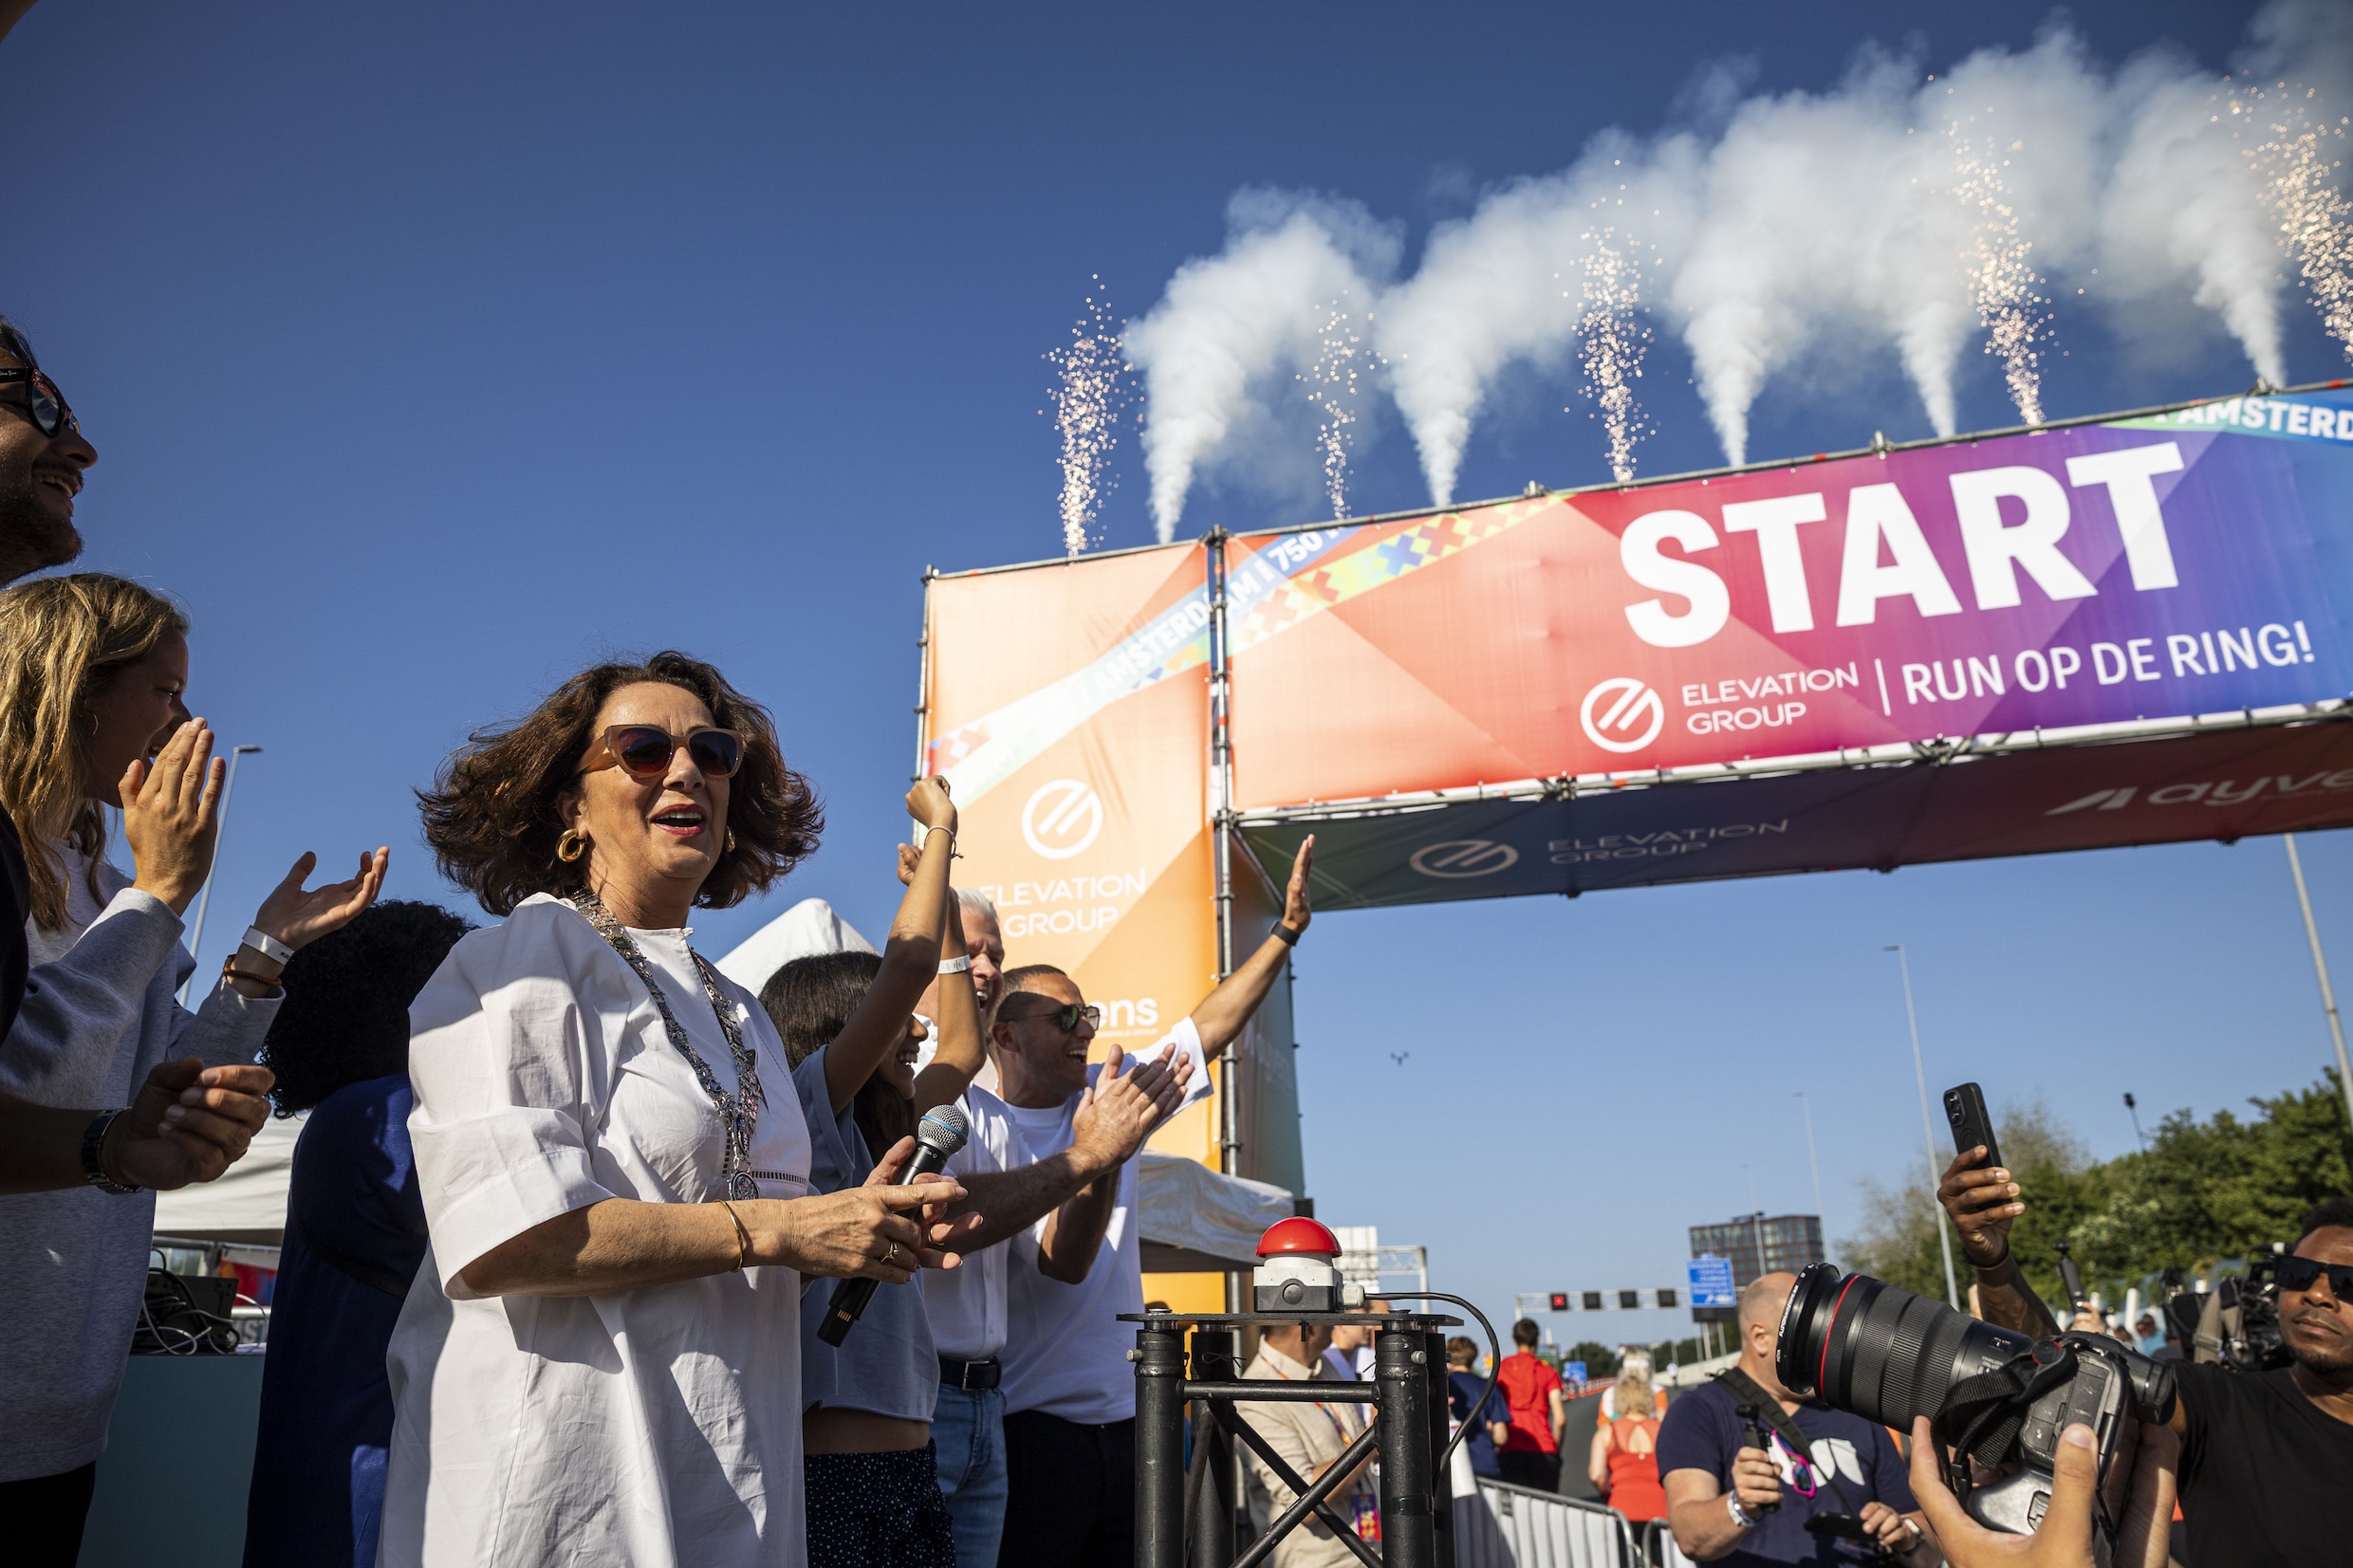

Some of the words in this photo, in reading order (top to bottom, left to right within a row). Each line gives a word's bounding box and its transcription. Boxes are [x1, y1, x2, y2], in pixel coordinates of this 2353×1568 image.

[1267, 529, 1324, 572] 750
[1619, 439, 2186, 649] START
[1901, 654, 2006, 706] RUN
[2014, 646, 2081, 693] OP
[2090, 637, 2161, 687] DE
[2166, 619, 2316, 678] RING!
[1681, 661, 1860, 708] ELEVATION
[1686, 701, 1807, 735] GROUP
[1548, 818, 1789, 853] ELEVATION
[1549, 840, 1708, 865] GROUP
[1003, 906, 1119, 938] GROUP
